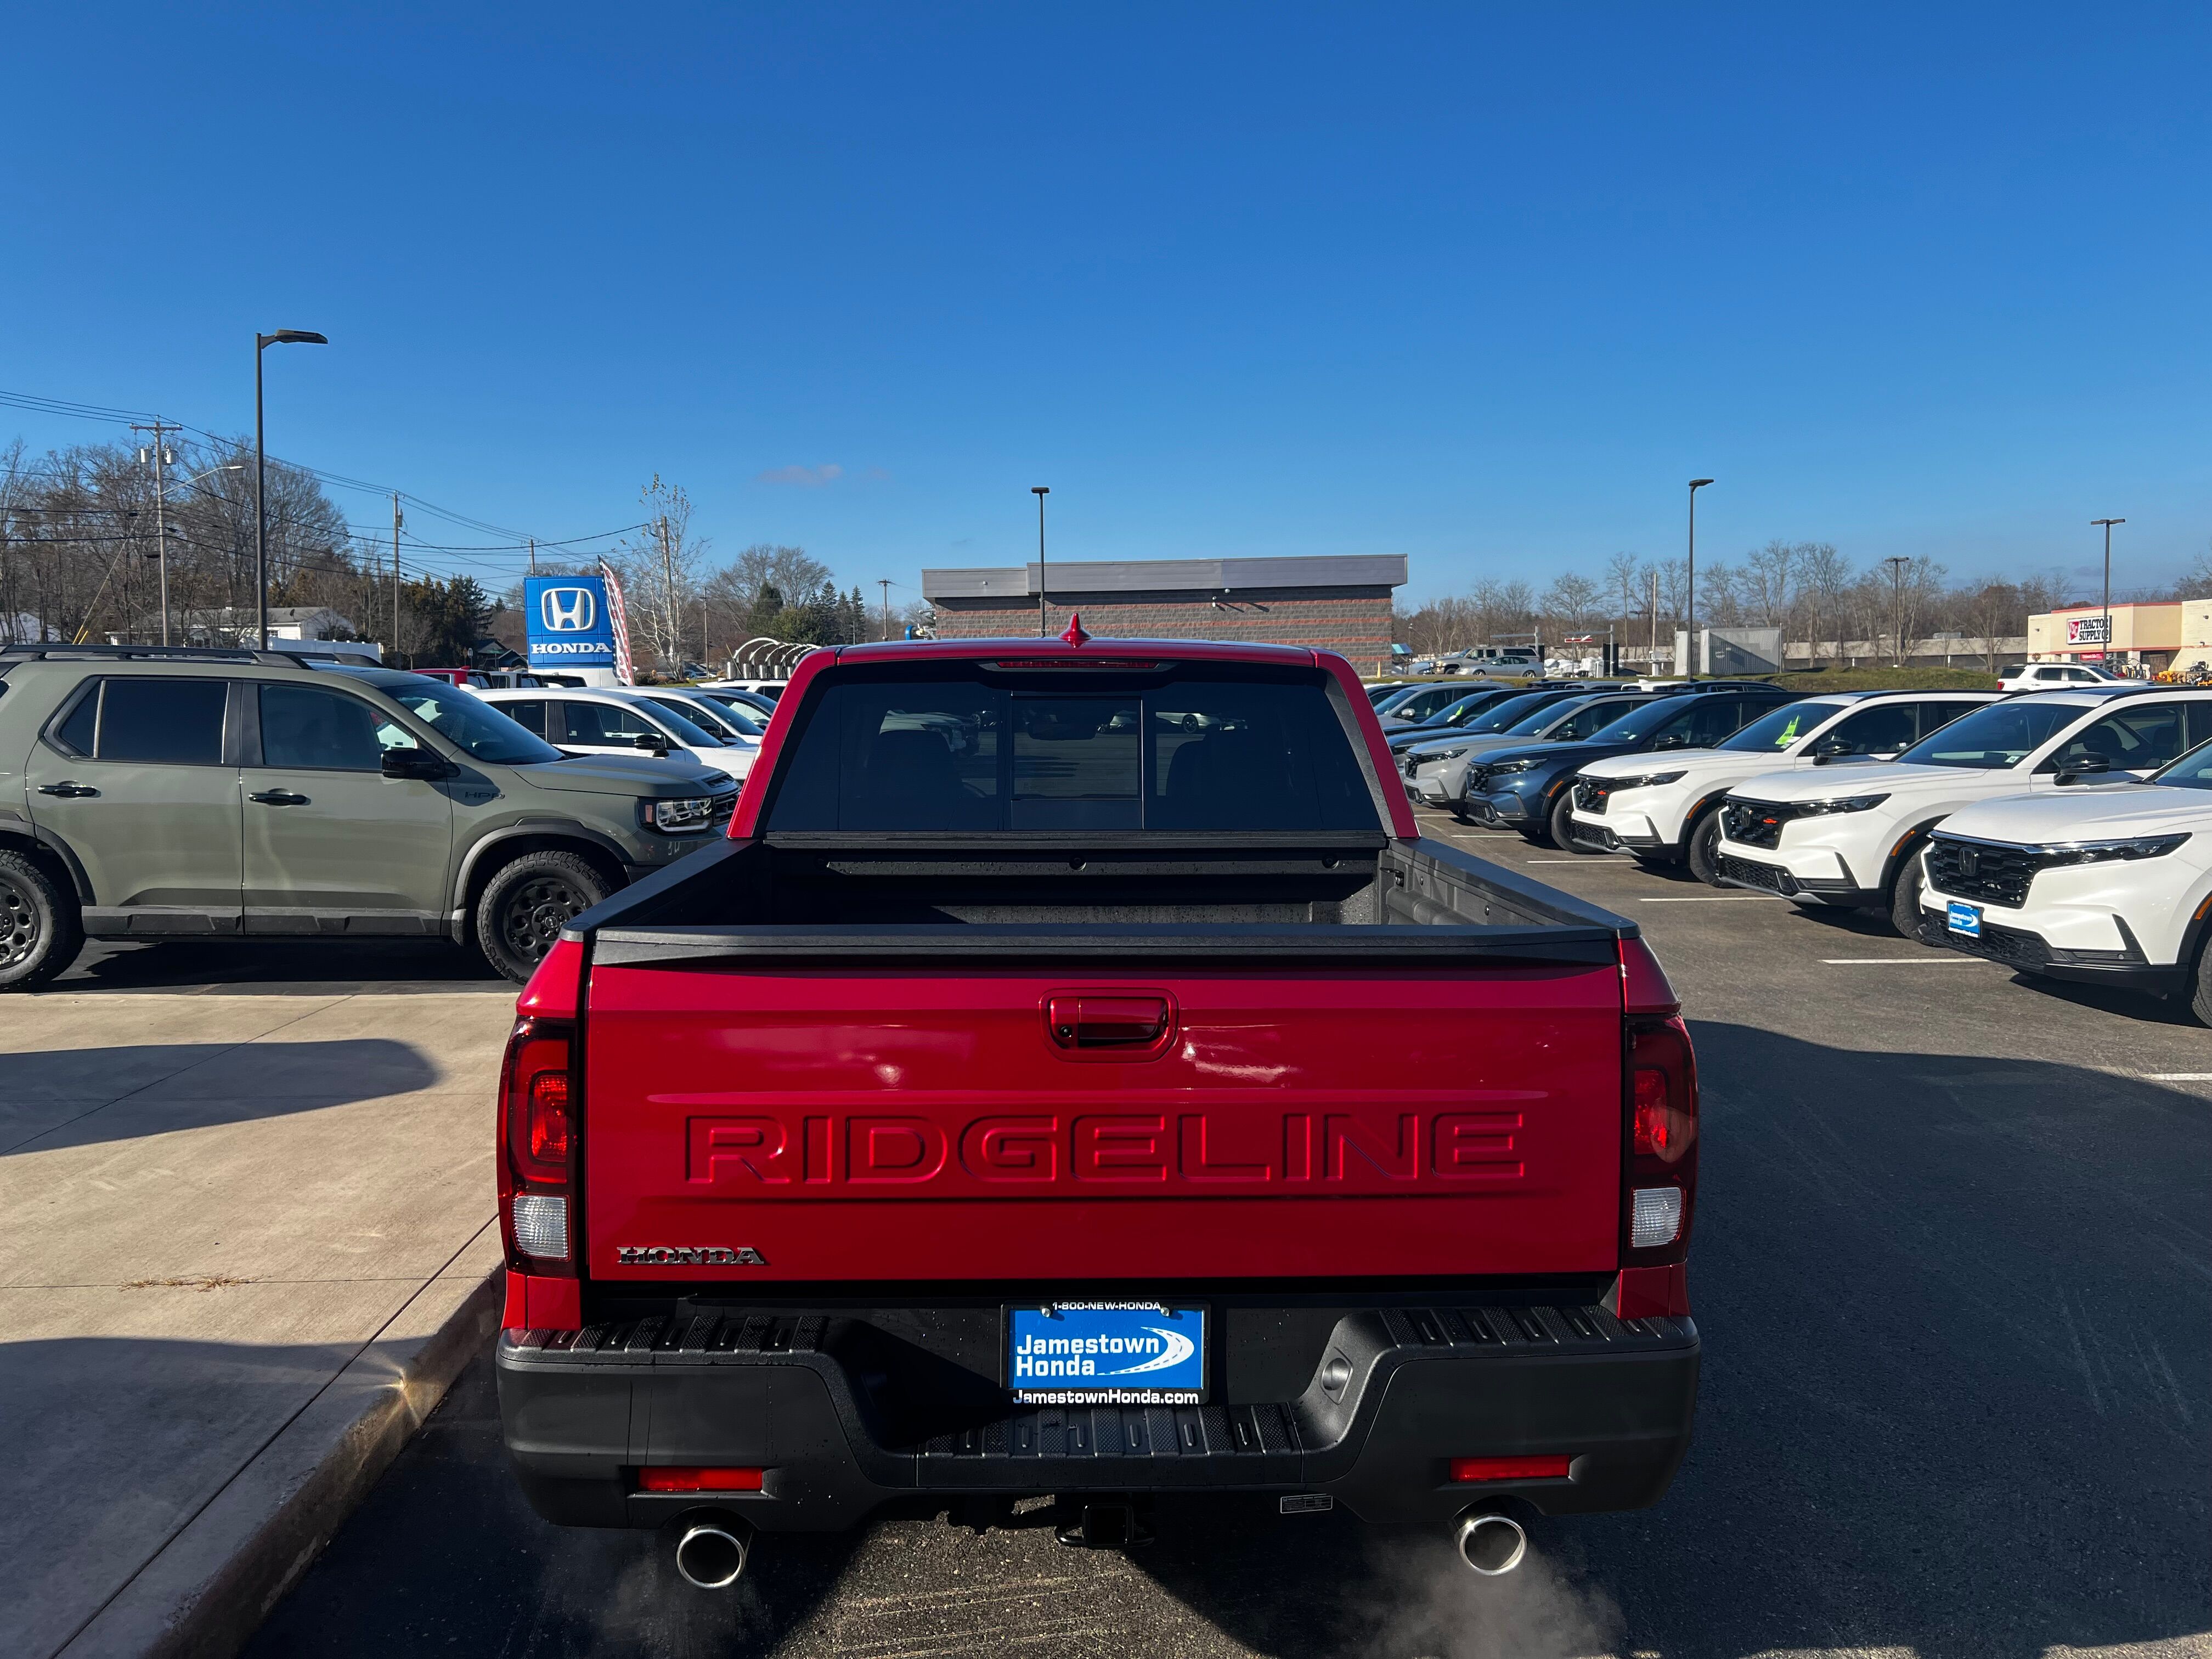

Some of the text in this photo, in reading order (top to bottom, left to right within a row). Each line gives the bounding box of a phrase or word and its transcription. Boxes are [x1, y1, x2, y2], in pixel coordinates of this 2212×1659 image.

[2080, 618, 2108, 630] TRACTO
[2079, 629, 2101, 641] SUPPLY
[531, 643, 612, 654] HONDA
[685, 1111, 1525, 1184] RIDGELINE
[617, 1246, 764, 1265] HONDA
[1052, 1302, 1161, 1310] 1-800-NEW-HONDA
[1017, 1334, 1159, 1355] Jamestown
[1016, 1355, 1095, 1376] Honda
[1013, 1389, 1198, 1404] JamestownHonda.com
